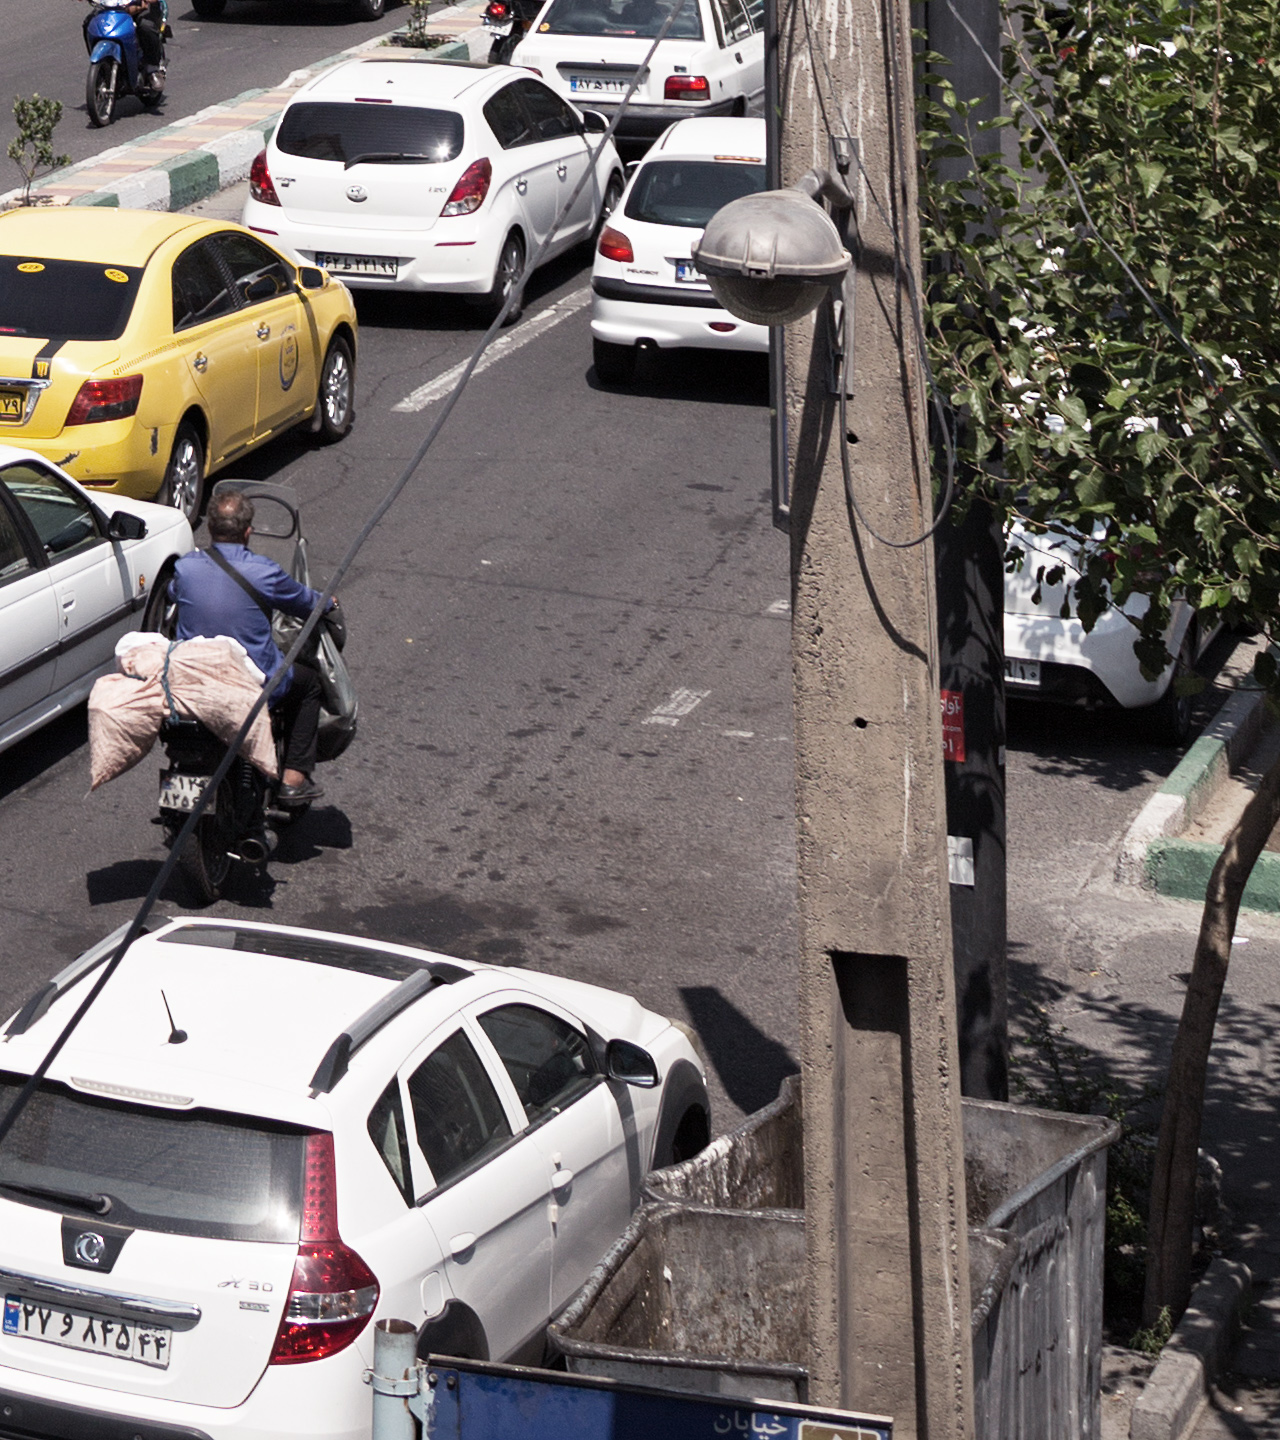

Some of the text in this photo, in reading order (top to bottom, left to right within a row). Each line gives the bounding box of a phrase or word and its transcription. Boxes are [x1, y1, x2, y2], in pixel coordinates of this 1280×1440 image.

[22, 1302, 53, 1336] ۲۷
[82, 1316, 131, 1352] ۸۴۵
[138, 1333, 167, 1360] ۴۴
[713, 1410, 788, 1440] خیابان
